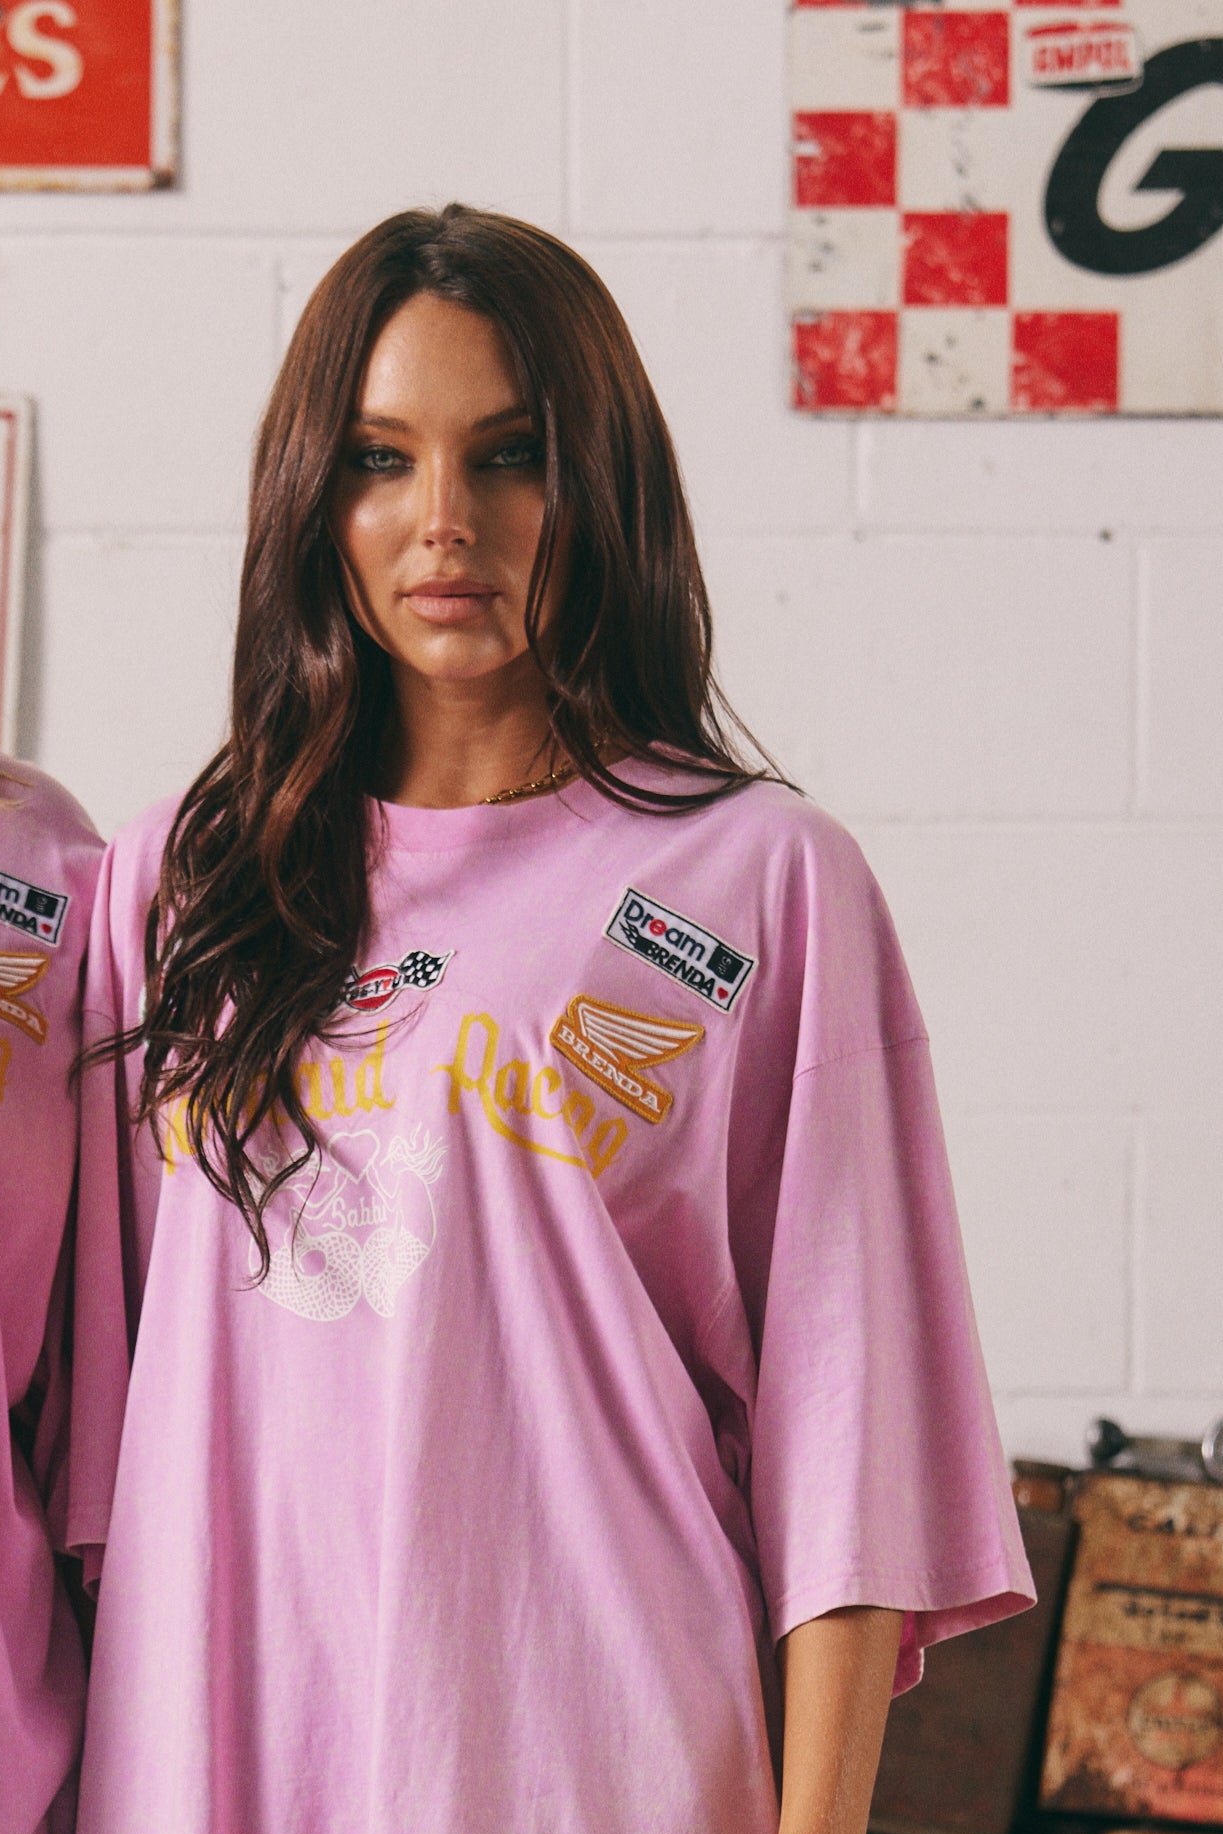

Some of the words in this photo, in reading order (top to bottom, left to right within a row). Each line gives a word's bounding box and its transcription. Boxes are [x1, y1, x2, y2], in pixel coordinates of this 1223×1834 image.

[624, 899, 706, 961] Dream
[645, 943, 717, 998] BRENDA
[558, 1025, 661, 1114] BRENDA
